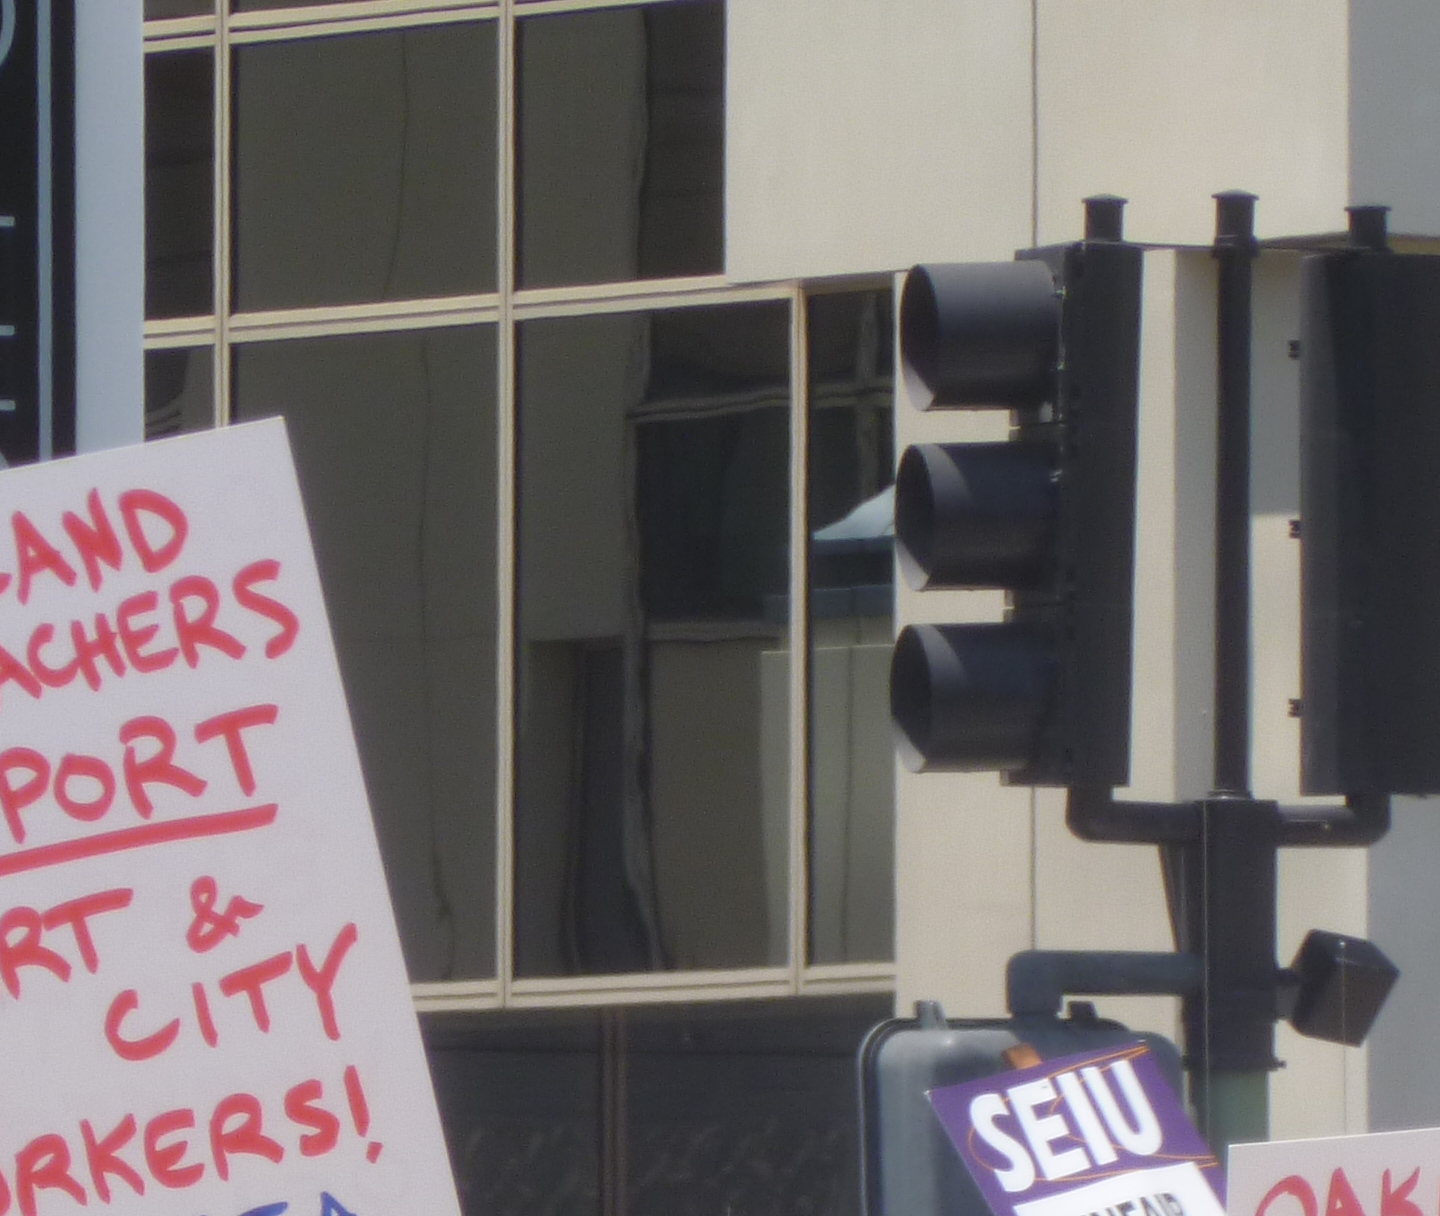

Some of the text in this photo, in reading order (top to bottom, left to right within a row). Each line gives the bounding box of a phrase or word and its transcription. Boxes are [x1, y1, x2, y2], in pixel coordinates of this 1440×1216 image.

[185, 874, 265, 955] &
[103, 922, 358, 1062] CITY
[968, 1058, 1164, 1193] SEIU
